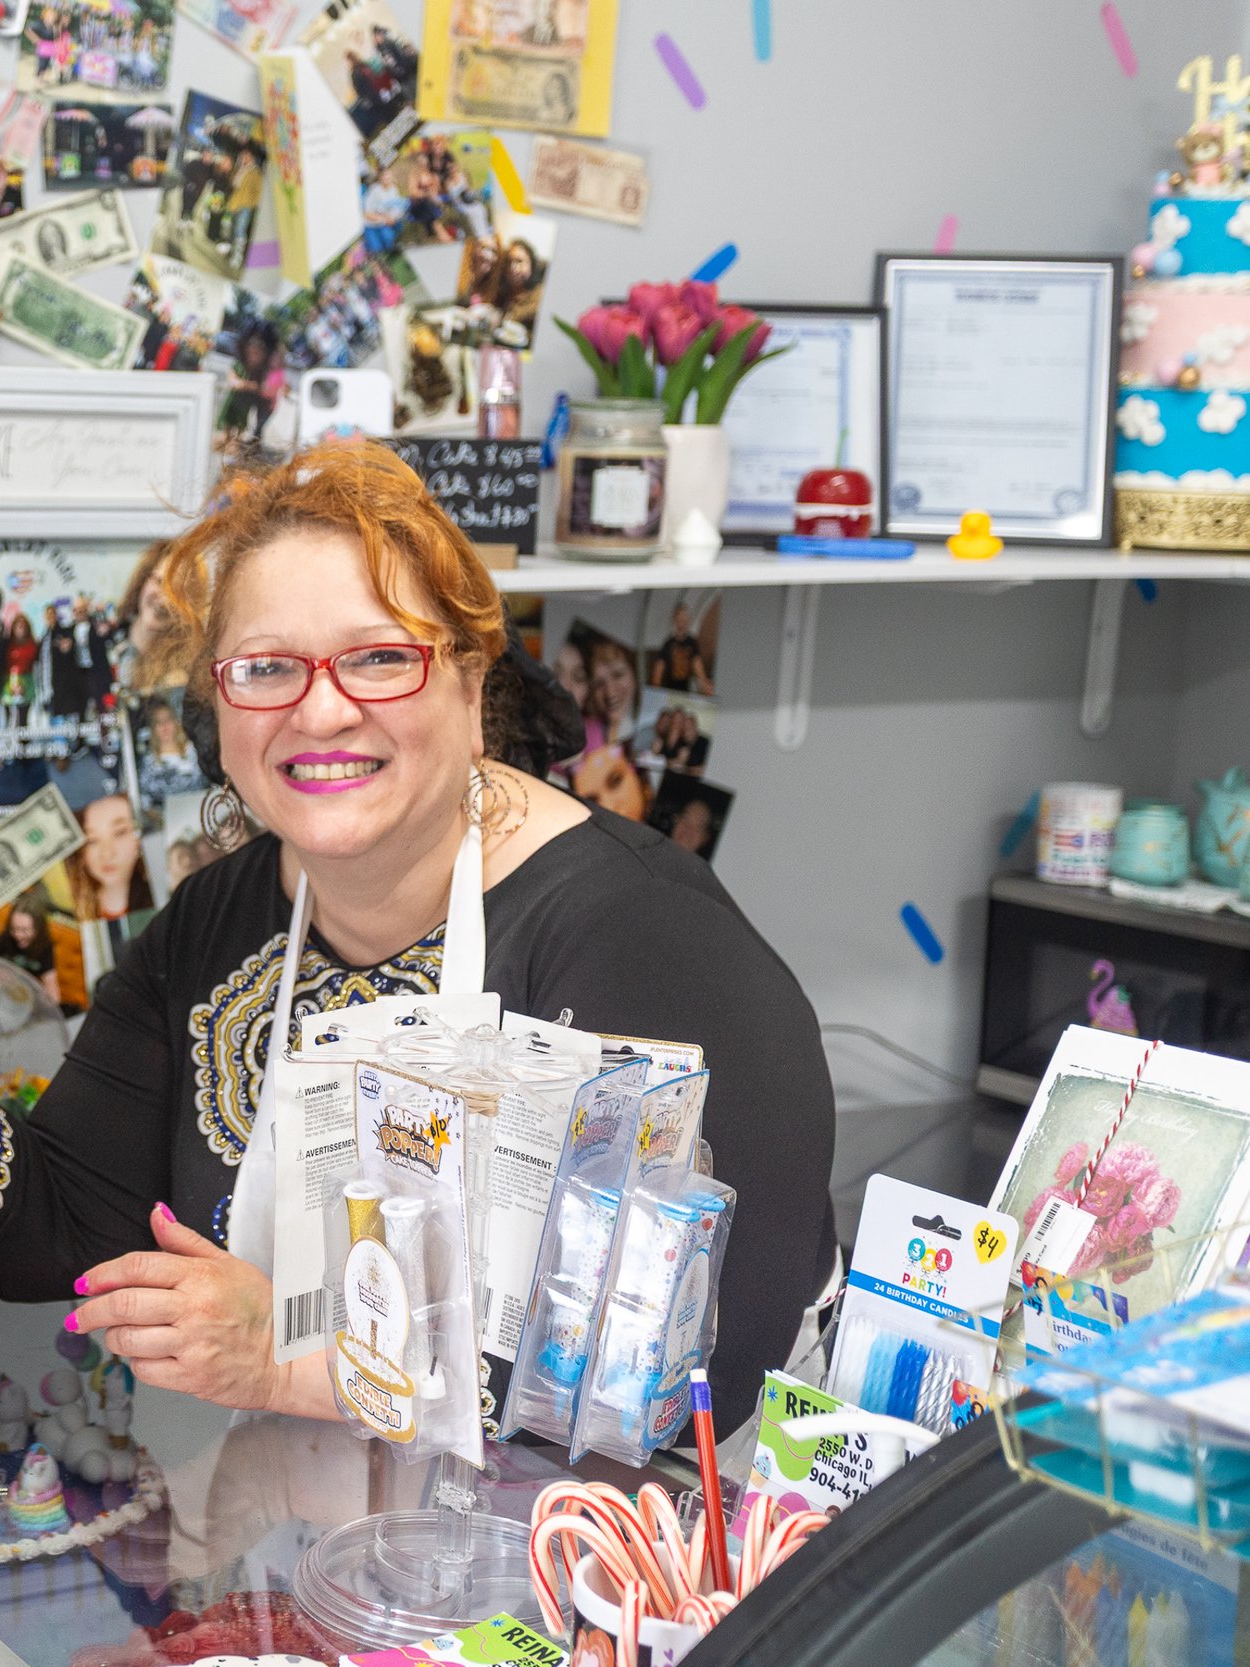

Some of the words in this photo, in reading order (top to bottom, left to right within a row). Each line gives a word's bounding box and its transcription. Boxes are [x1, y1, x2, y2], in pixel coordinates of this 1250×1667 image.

[304, 1081, 341, 1096] WARNING:
[359, 1075, 382, 1093] PARTY
[384, 1104, 430, 1138] PARTY
[305, 1138, 356, 1158] AVERTISSEMEN
[380, 1123, 442, 1175] POPPER!
[494, 1145, 553, 1170] VERTISSEMENT
[977, 1227, 999, 1258] $4
[874, 1282, 885, 1293] 24
[886, 1286, 928, 1308] BIRTHDAY
[902, 1272, 947, 1298] PARTY!
[1052, 1320, 1093, 1345] irthda
[348, 1380, 401, 1429] CONFETTI
[356, 1373, 392, 1407] EDIBLE
[814, 1449, 857, 1479] Chicago
[818, 1437, 846, 1458] 2550
[849, 1450, 863, 1468] W.
[809, 1467, 865, 1504] 904-41
[501, 1626, 565, 1667] REINA
